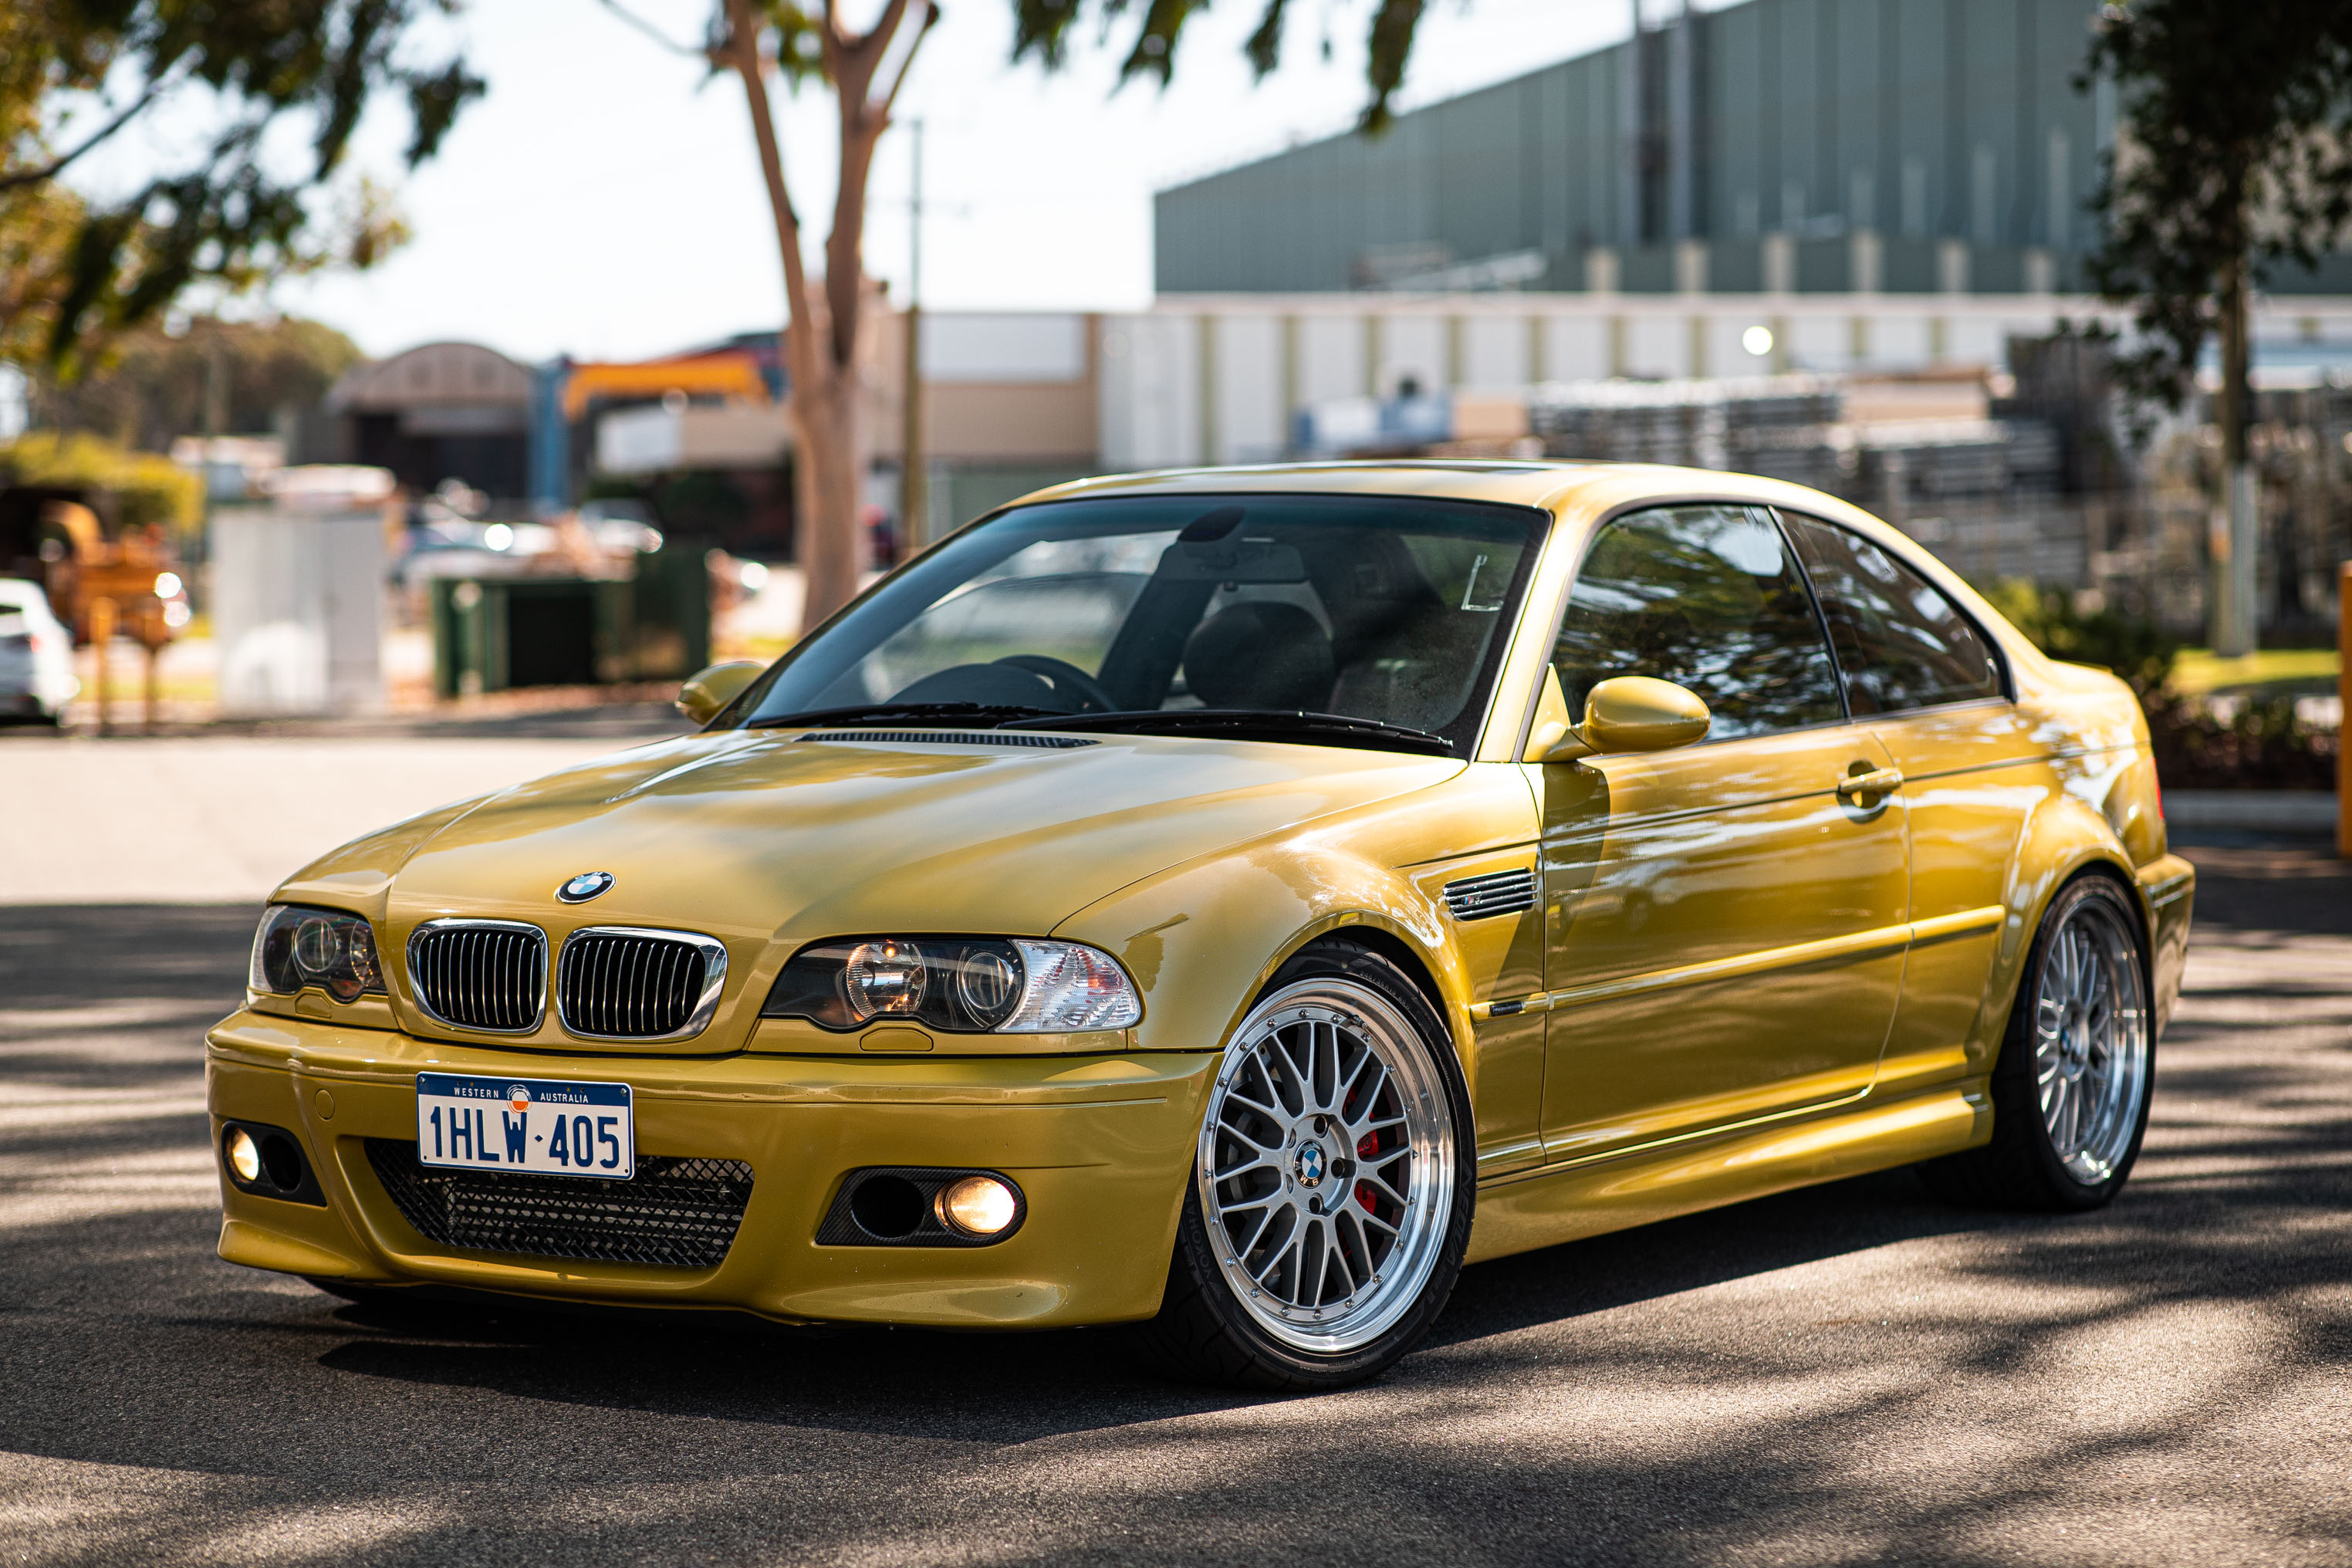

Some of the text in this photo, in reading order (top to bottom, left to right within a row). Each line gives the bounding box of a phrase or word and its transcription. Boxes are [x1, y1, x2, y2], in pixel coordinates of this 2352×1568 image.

[454, 1086, 589, 1103] WESTERN AUSTRALIA
[1184, 1181, 1211, 1279] YOKOHA
